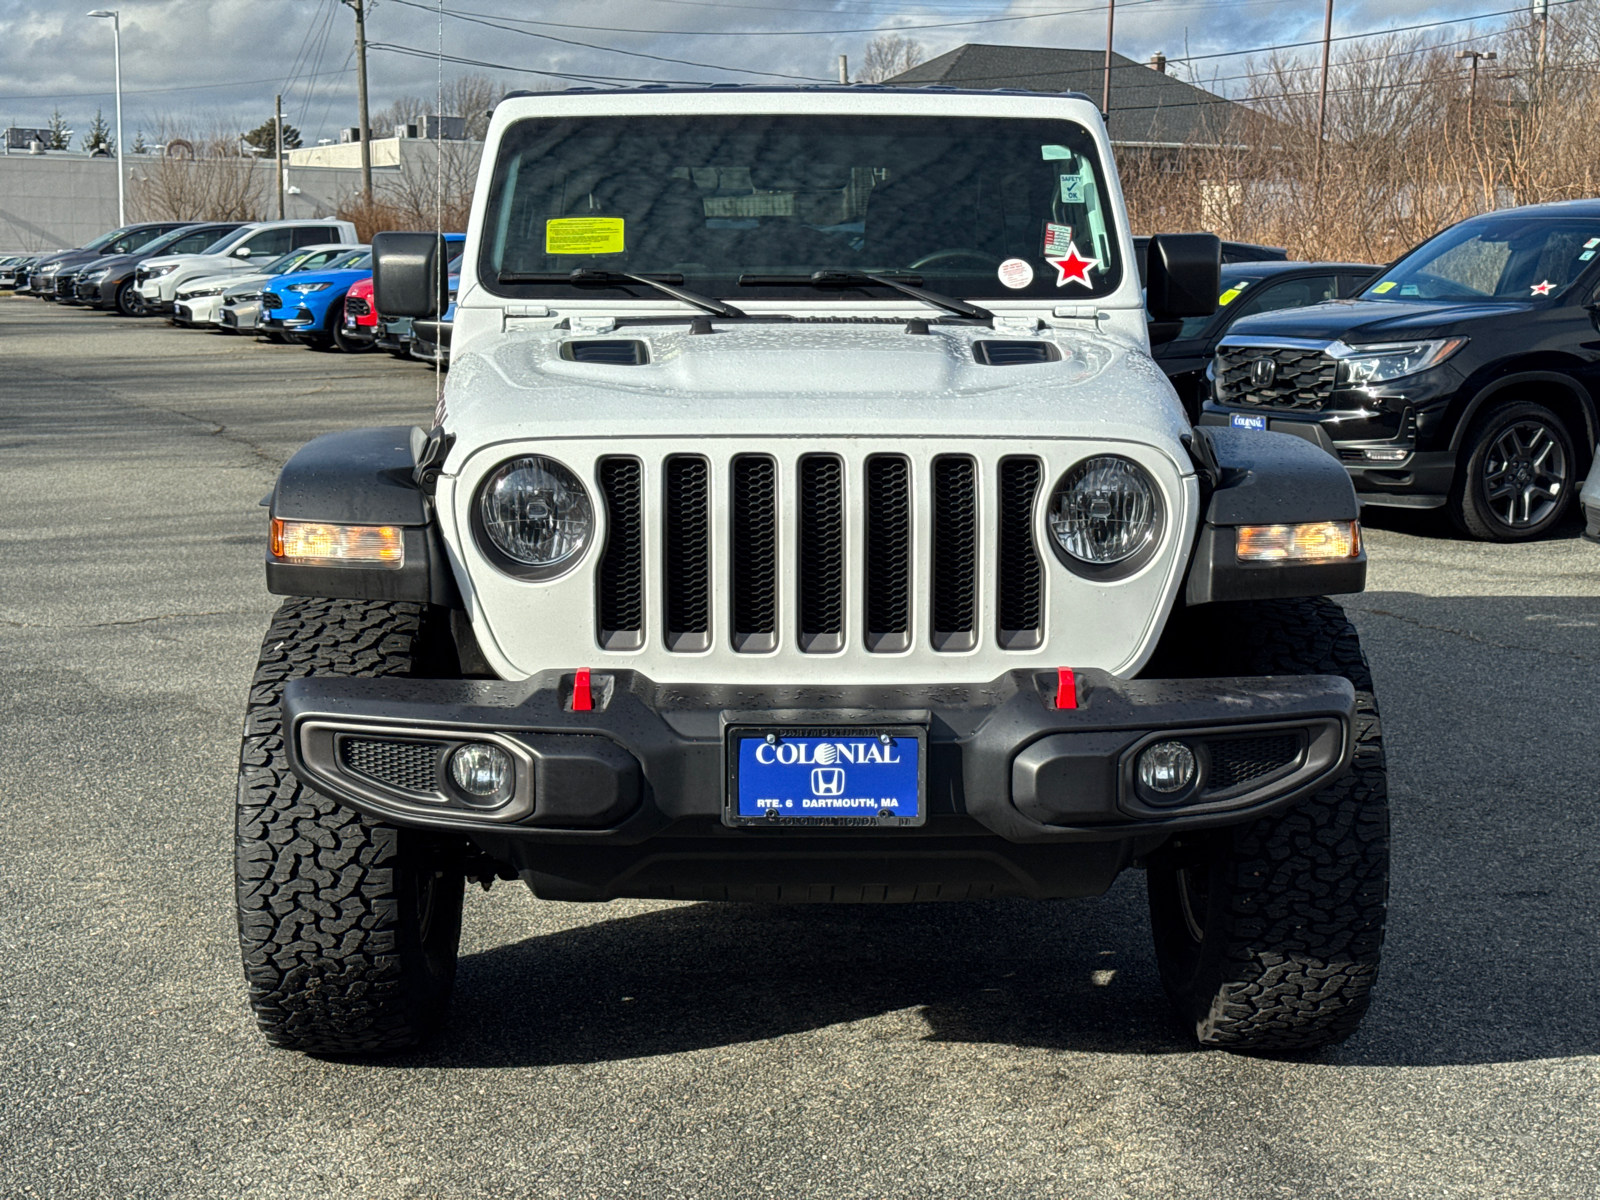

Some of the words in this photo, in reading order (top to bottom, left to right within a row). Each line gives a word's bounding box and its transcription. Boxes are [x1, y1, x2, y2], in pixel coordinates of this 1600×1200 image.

[755, 743, 900, 765] COLONIAL
[757, 799, 783, 808] RTE.
[785, 799, 794, 808] 6
[802, 798, 878, 809] DARTMOUTH,
[880, 798, 899, 807] MA
[838, 817, 878, 826] HONDA
